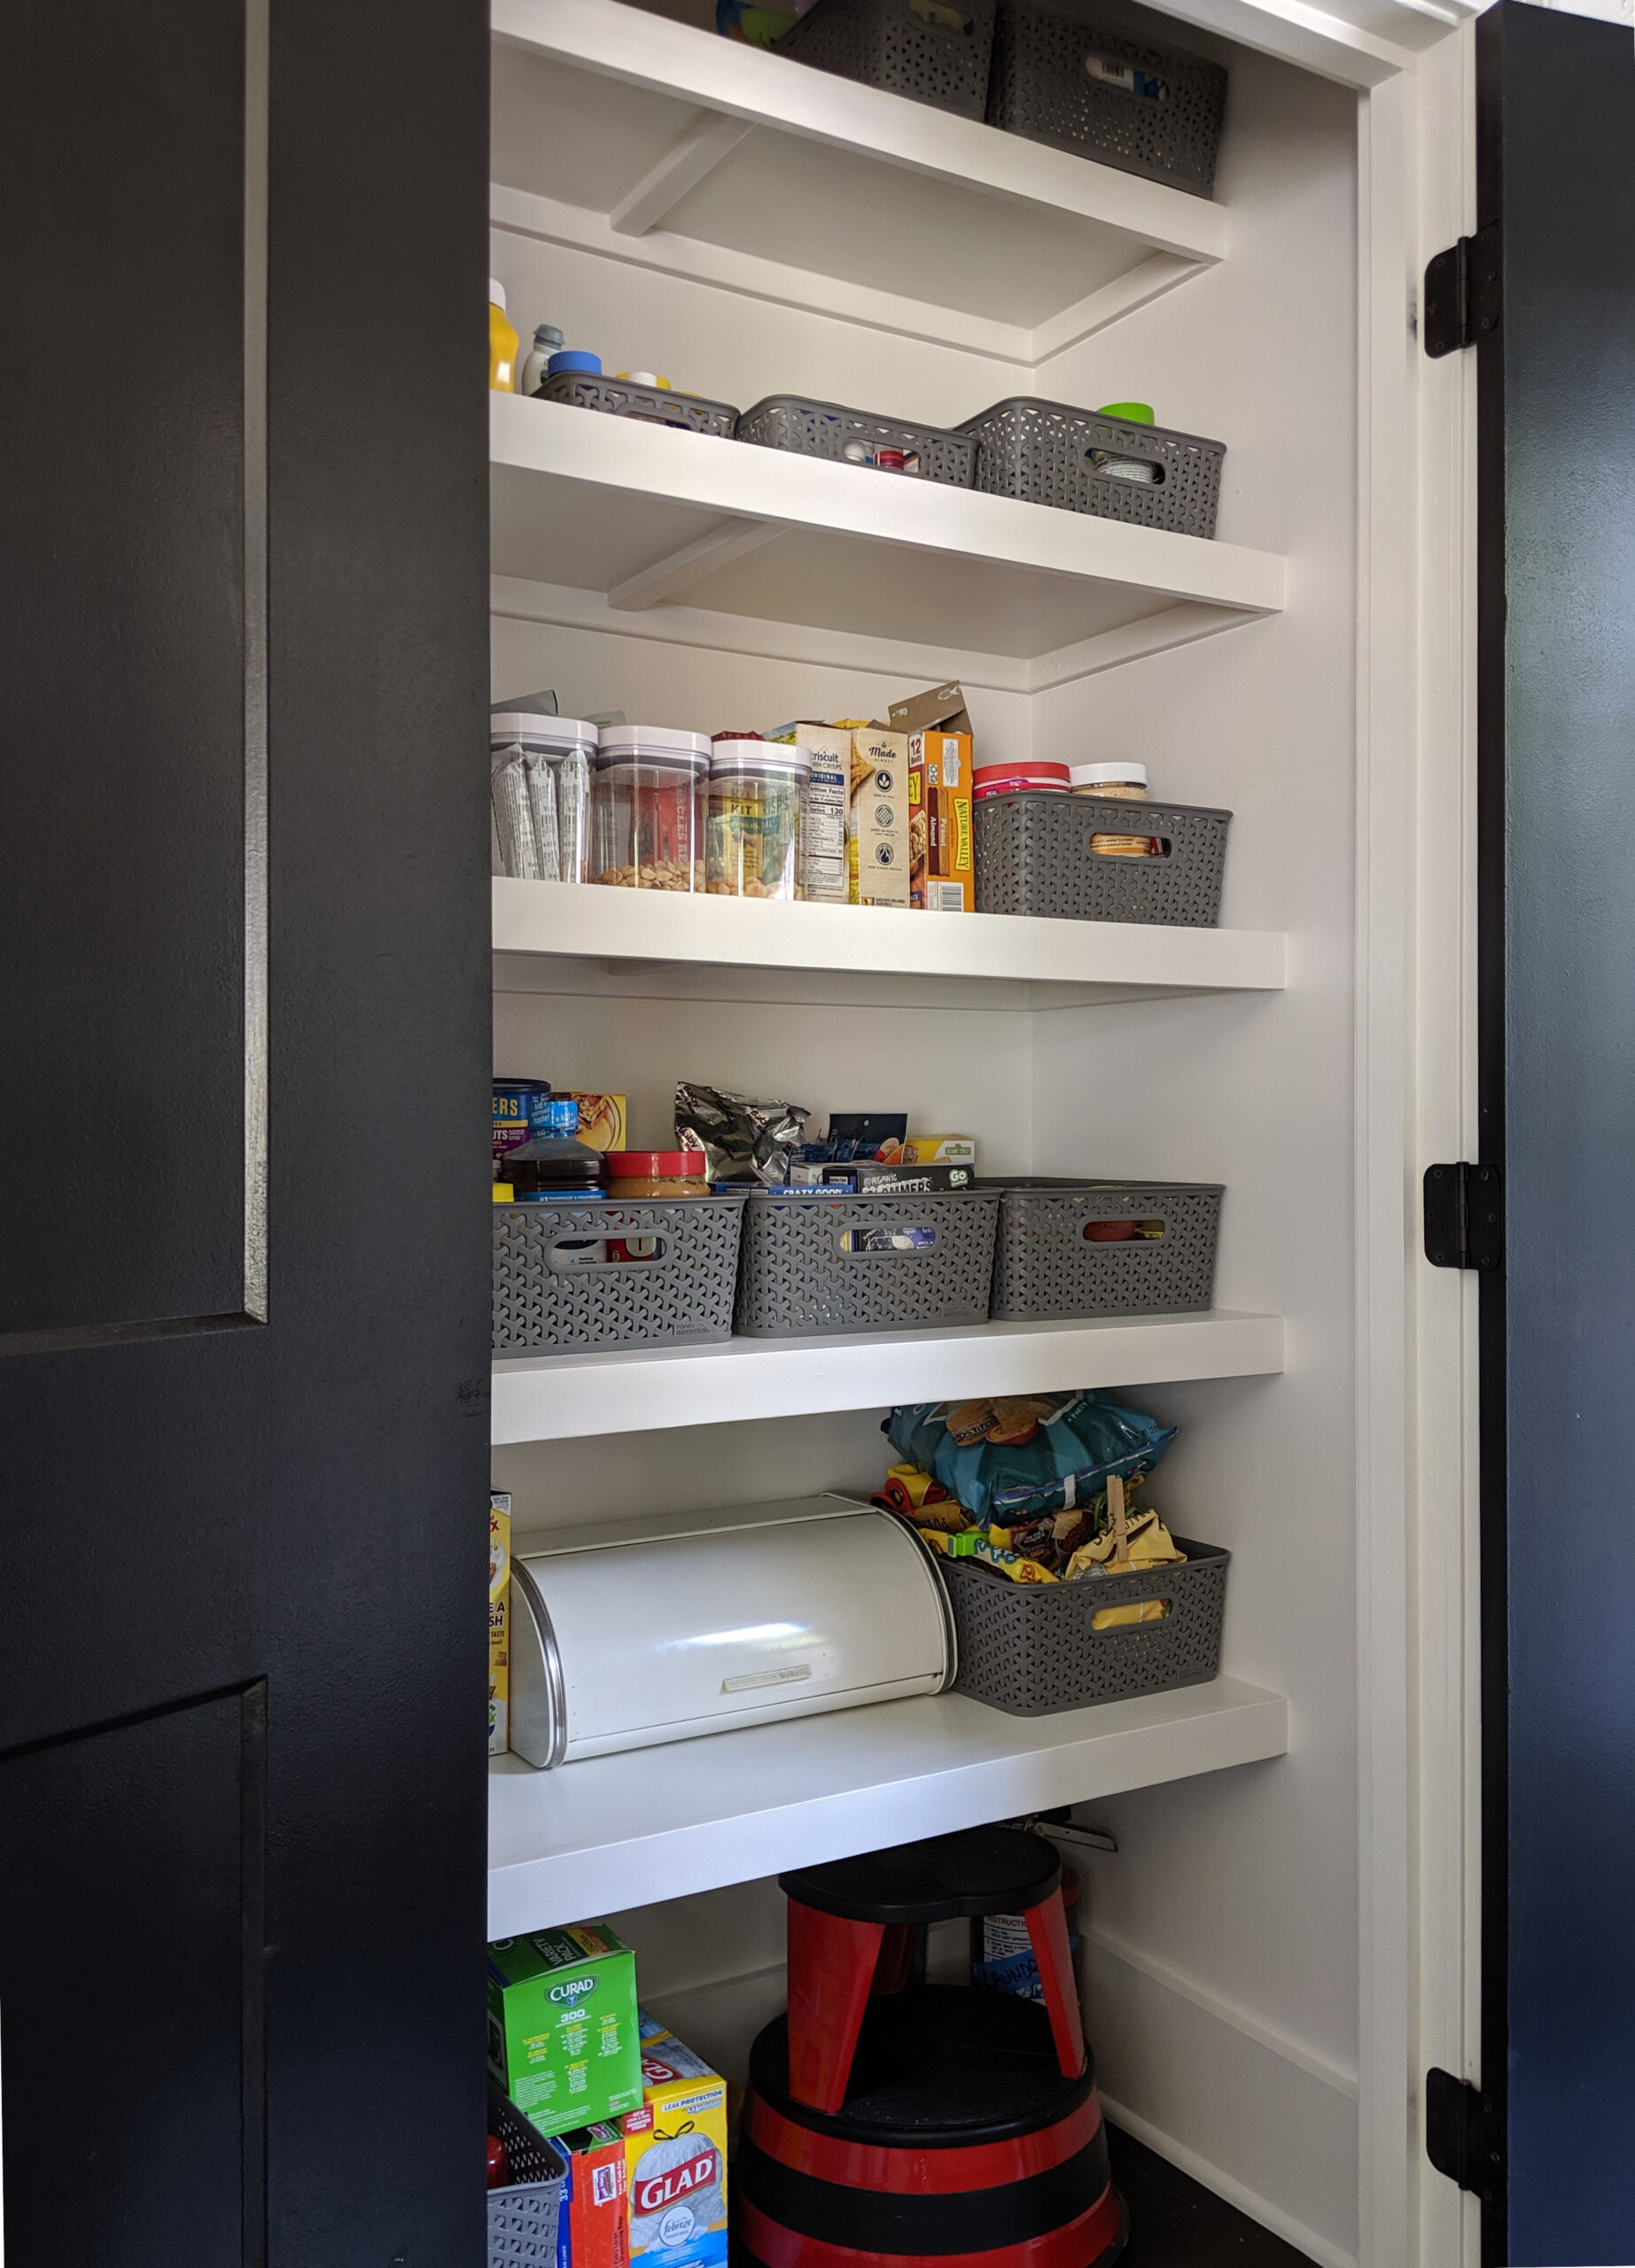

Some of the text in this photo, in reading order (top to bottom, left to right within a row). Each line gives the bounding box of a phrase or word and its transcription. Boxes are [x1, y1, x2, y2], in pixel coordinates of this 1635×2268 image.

[868, 746, 897, 759] Made
[910, 738, 922, 755] 12
[730, 804, 753, 816] KIT
[955, 801, 970, 869] NATURE VALLEY
[863, 1172, 898, 1187] ORGANIC
[986, 1915, 1027, 1928] NSTRUCTIO
[533, 1938, 565, 1966] VARIETY
[552, 1942, 577, 1961] PACK
[549, 1979, 594, 2001] CURAD
[561, 2008, 586, 2023] 300
[664, 2090, 723, 2111] LEAK PROTECTION
[641, 2158, 713, 2210] GLAD
[559, 2188, 569, 2202] 33
[664, 2218, 692, 2236] febreze
